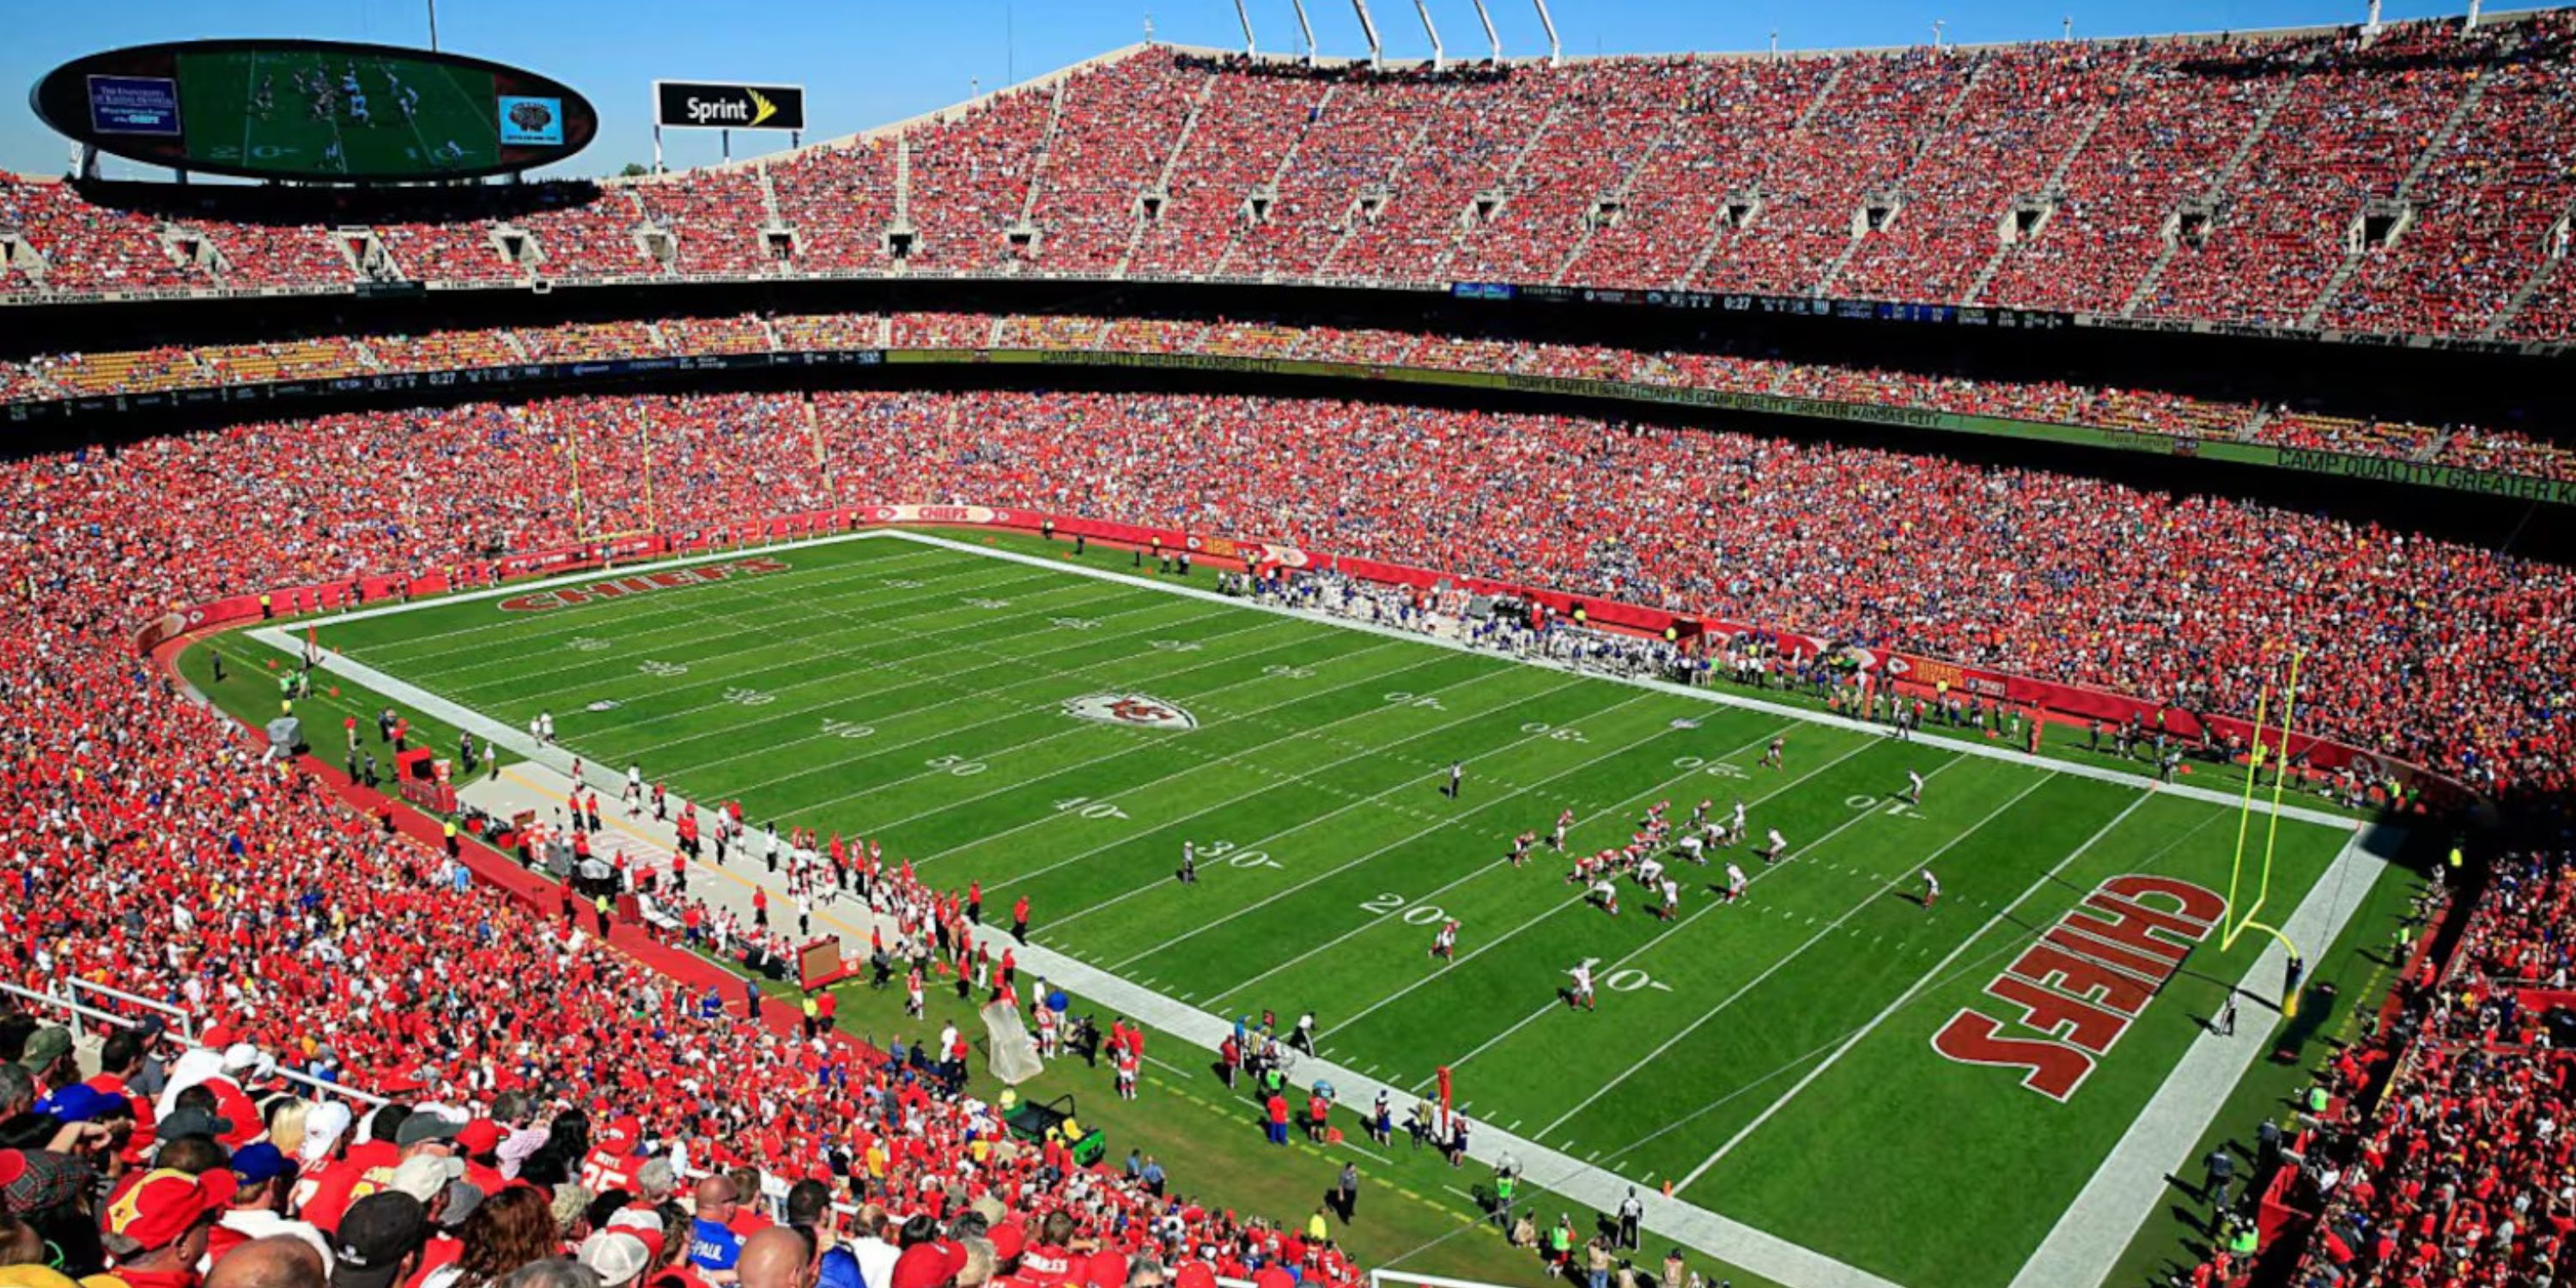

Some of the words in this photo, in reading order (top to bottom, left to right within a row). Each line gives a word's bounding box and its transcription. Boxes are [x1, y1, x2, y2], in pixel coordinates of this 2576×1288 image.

[687, 97, 749, 124] Sprint
[1724, 296, 1751, 311] 0:27
[1040, 351, 1079, 364] CAMP
[1086, 352, 1136, 366] QUALITY
[1139, 353, 1194, 367] GREATER
[1197, 355, 1243, 369] KANSAS
[1247, 358, 1279, 372] CITY
[429, 372, 456, 385] 0:27
[1696, 390, 1733, 404] CAMP
[1736, 393, 1789, 411] QUALITY
[1791, 399, 1849, 417] GREATER
[1852, 405, 1905, 422] KANSAS
[1908, 413, 1942, 427] CITY
[2277, 449, 2340, 471] CAMP
[2345, 458, 2441, 483] QUALITY
[2448, 471, 2552, 501] GREATER
[919, 507, 969, 519] CHIEFS
[497, 556, 793, 611] CHIEFS
[1053, 797, 1118, 818] 40
[1195, 841, 1268, 867] 30
[1359, 892, 1444, 925] 20
[1930, 874, 2229, 1103] CHIEFS
